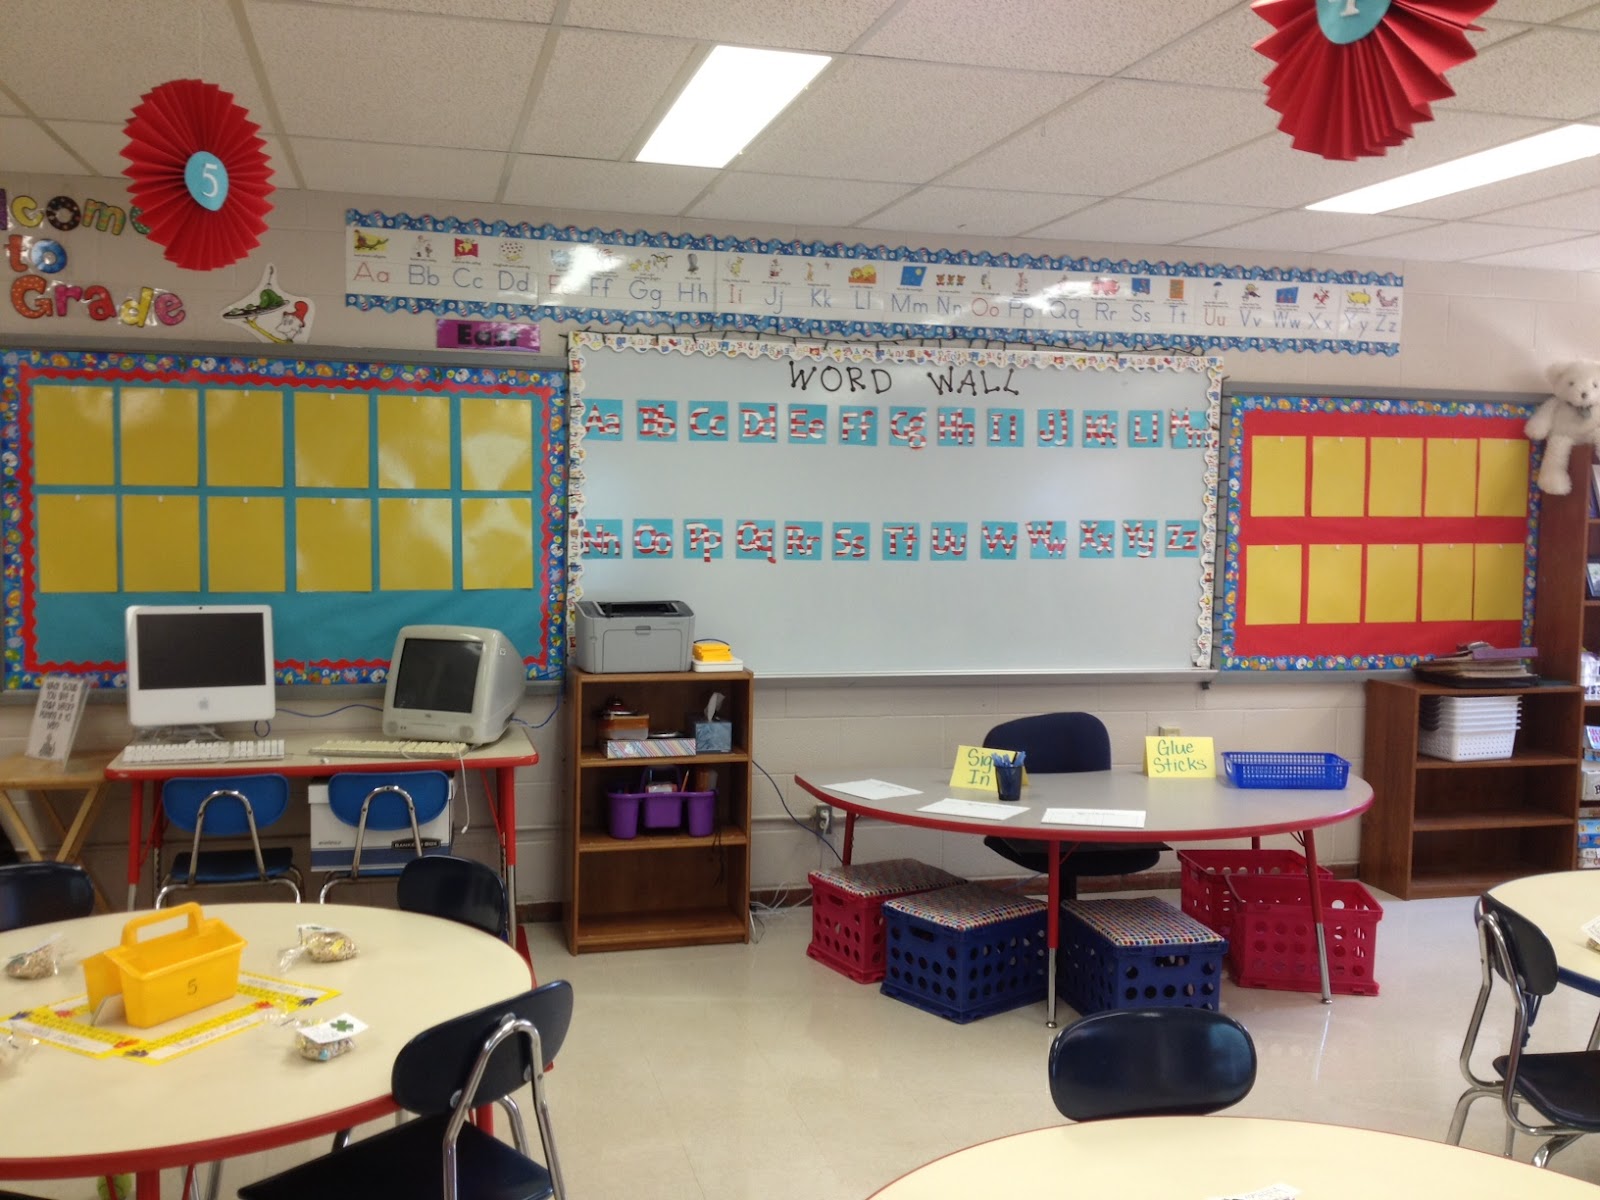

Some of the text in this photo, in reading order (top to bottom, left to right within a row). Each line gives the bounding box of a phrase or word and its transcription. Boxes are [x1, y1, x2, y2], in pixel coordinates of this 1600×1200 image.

[202, 163, 218, 198] 5
[5, 234, 67, 274] to
[10, 274, 186, 327] Grade
[353, 261, 390, 283] Aa
[409, 265, 440, 285] Bb
[453, 268, 483, 289] Cc
[498, 271, 529, 292] Dd
[591, 277, 613, 298] Ff
[629, 279, 662, 309] Gg
[678, 283, 708, 303] Hh
[729, 284, 742, 304] Ii
[764, 286, 783, 314] Jj
[810, 288, 832, 309] Kk
[855, 291, 870, 310] Ll
[891, 294, 928, 313] Mm
[937, 296, 962, 314] Nn
[972, 298, 999, 317] Oo
[1008, 299, 1034, 325] Pp
[1050, 300, 1083, 328] Qq
[1096, 302, 1117, 320] Rr
[1132, 304, 1151, 322] Ss
[1169, 305, 1186, 324] Tt
[1204, 308, 1226, 326] Uu
[1240, 310, 1262, 327] Vv
[1273, 311, 1300, 329] Ww
[1308, 312, 1331, 330] Xx
[1344, 312, 1368, 338] Yy
[1376, 314, 1396, 332] Zz
[788, 360, 1019, 396] WORD WALL
[585, 403, 621, 435] Aa
[638, 404, 677, 438] Bb
[689, 407, 726, 436] Cc
[741, 405, 776, 440] Dd
[790, 409, 825, 439] Ee
[842, 410, 874, 441] Ff
[891, 411, 927, 450] Gg
[939, 408, 975, 445] Hh
[990, 413, 1017, 442] Ii
[1039, 409, 1068, 446] Jj
[1085, 414, 1117, 445] Kk
[1134, 413, 1159, 443] Ll
[583, 524, 621, 556] Nn
[633, 523, 672, 555] Oo
[686, 522, 722, 563] Pp
[736, 521, 776, 564] Qq
[785, 526, 820, 556] Rr
[835, 528, 865, 557] Ss
[884, 526, 917, 557] Tt
[932, 527, 966, 556] Uu
[1025, 521, 1067, 556] Ww
[1080, 520, 1113, 555] Xx
[1122, 520, 1154, 558] Yy
[1166, 524, 1198, 550] Zz
[968, 748, 994, 774] Sig
[1153, 757, 1207, 773] Sticks
[1157, 739, 1194, 756] Glue
[968, 769, 990, 786] In
[187, 978, 198, 996] 5
